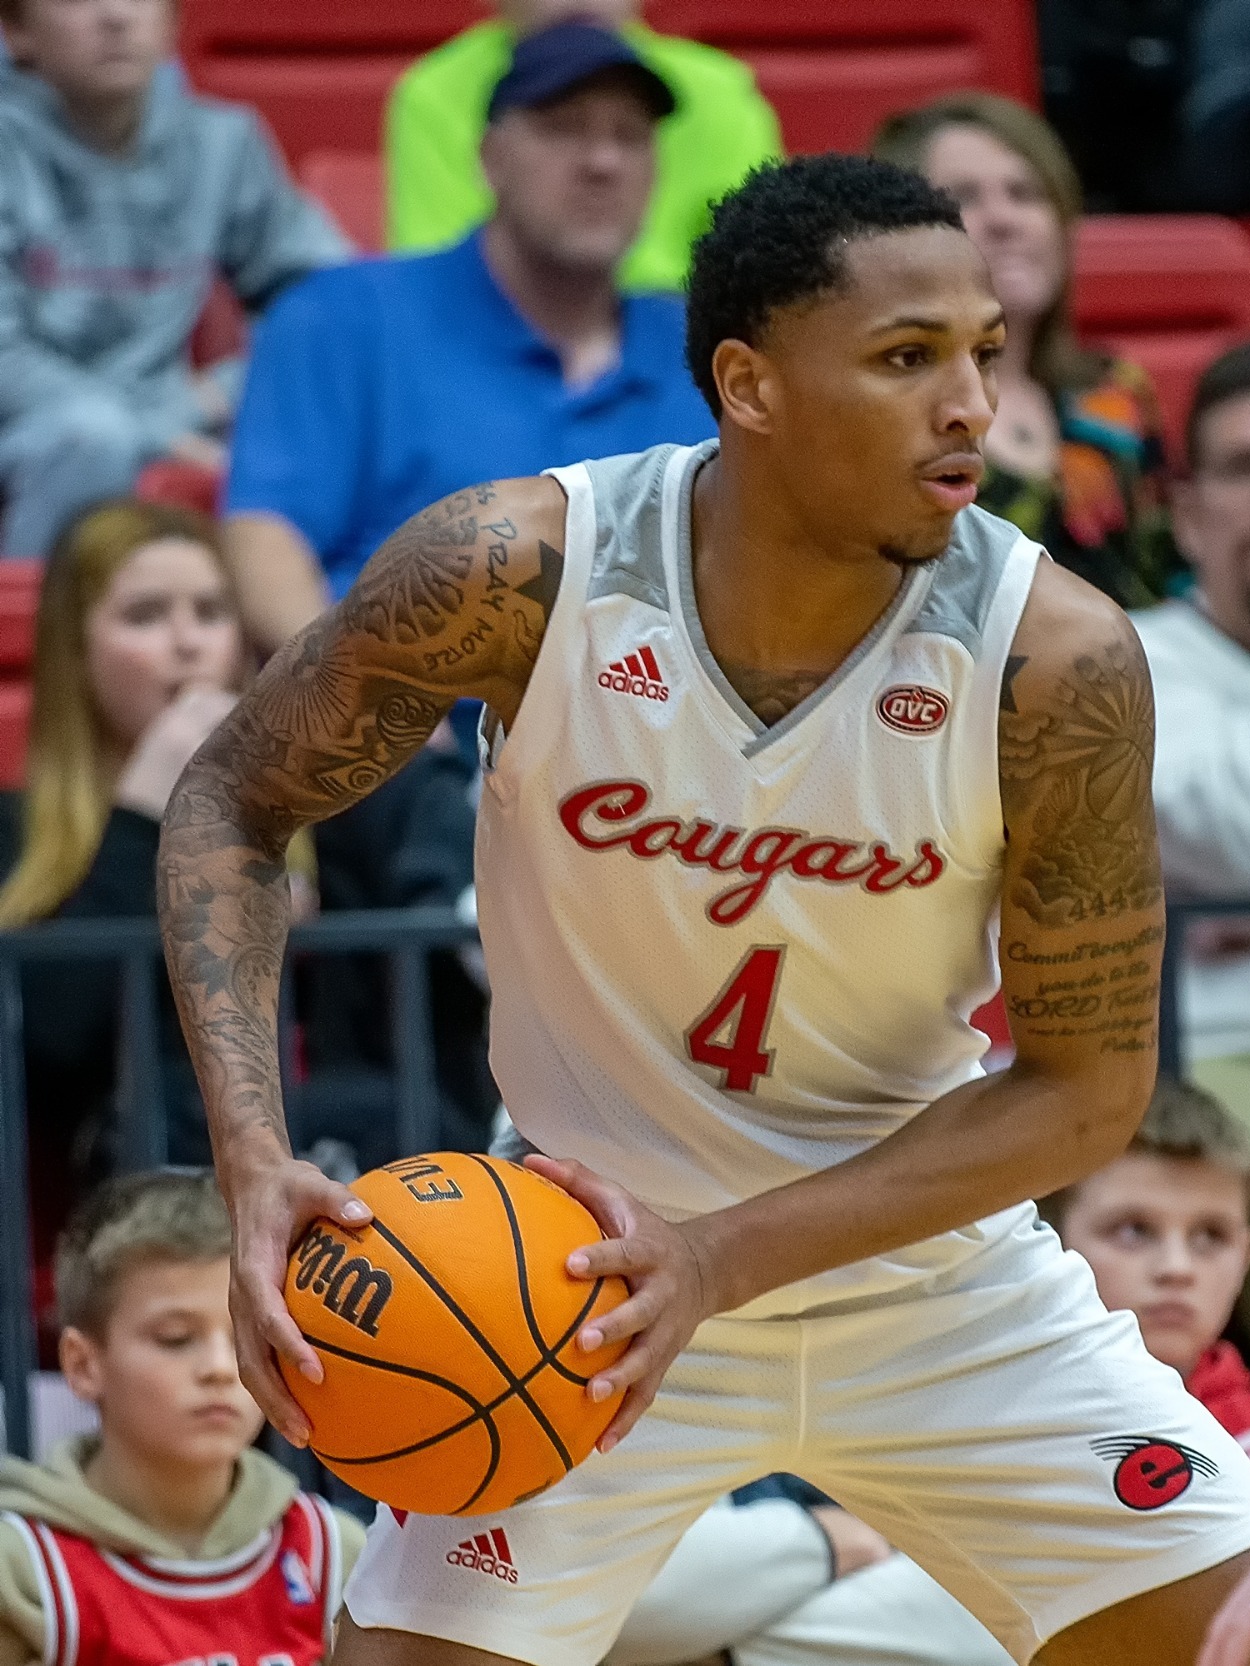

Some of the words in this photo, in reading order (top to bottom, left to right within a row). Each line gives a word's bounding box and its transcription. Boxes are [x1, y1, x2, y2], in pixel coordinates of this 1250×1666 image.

[598, 671, 669, 702] adidas
[889, 698, 938, 722] OVC
[558, 779, 948, 927] Cougars
[684, 944, 787, 1095] 4
[383, 1157, 464, 1202] EV
[296, 1225, 393, 1337] Wils
[446, 1550, 518, 1584] adidas
